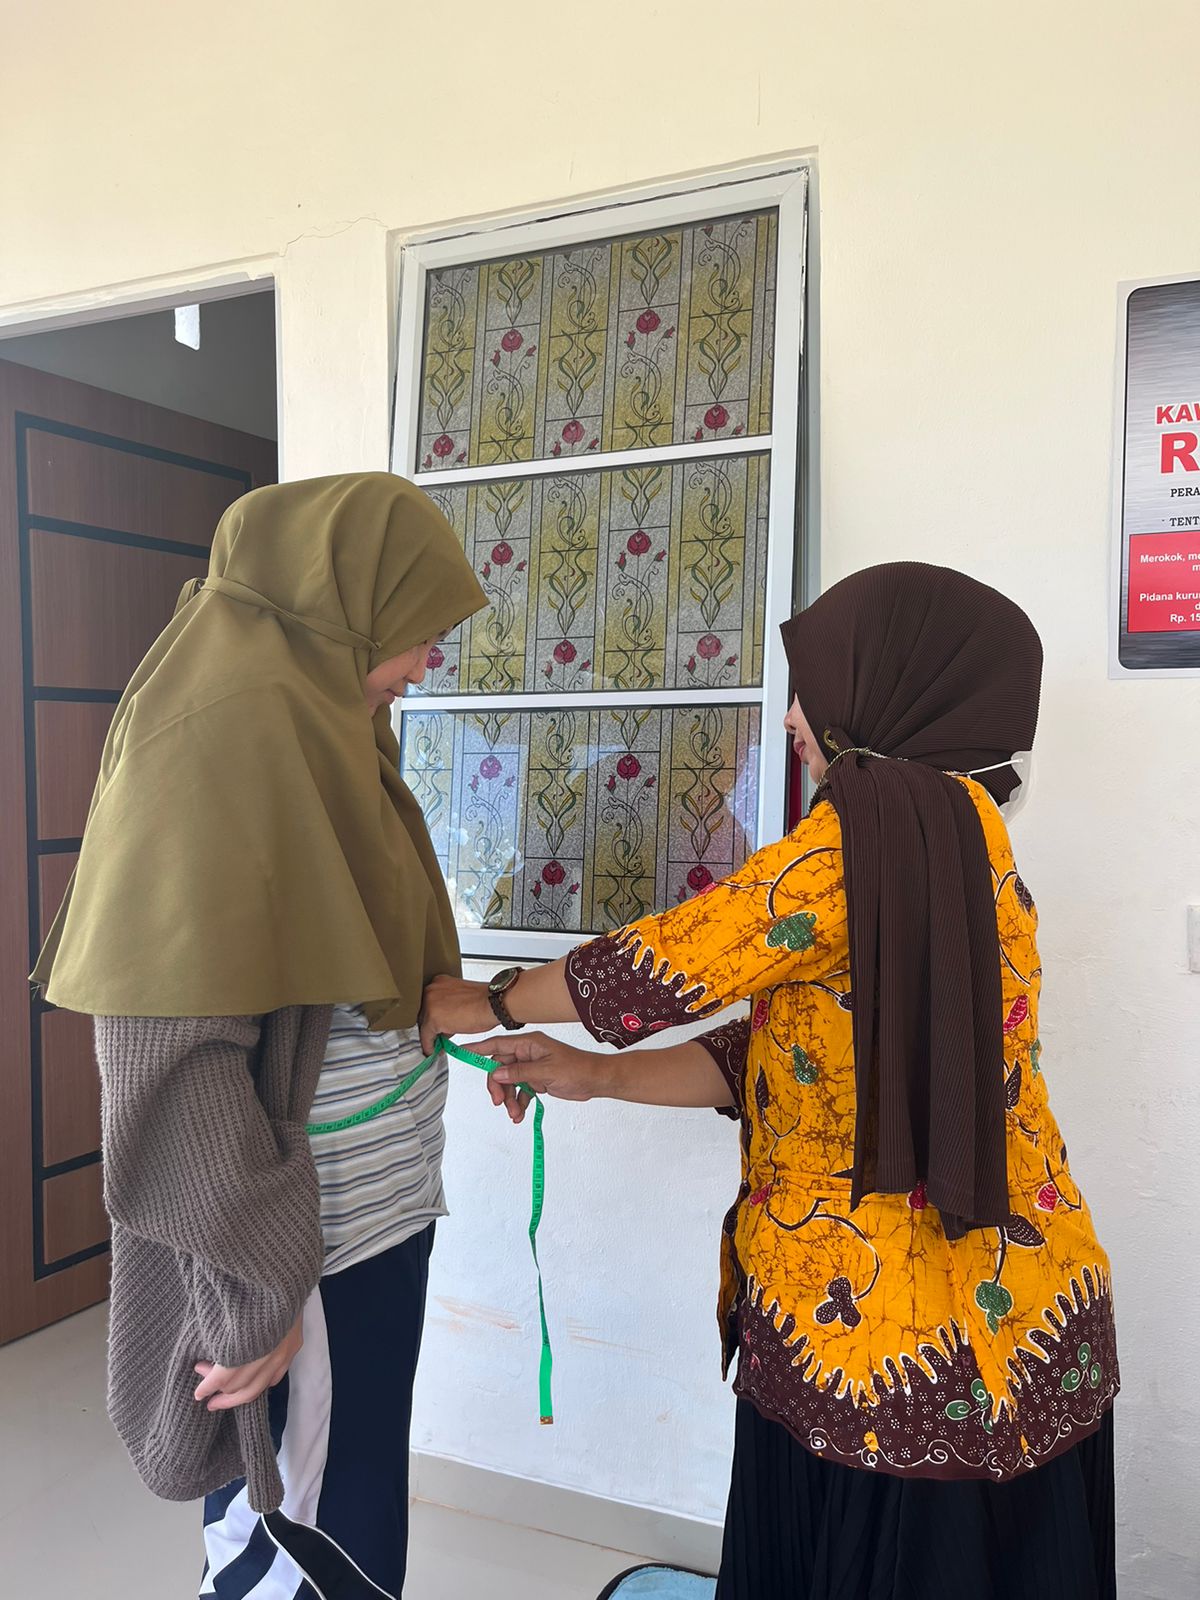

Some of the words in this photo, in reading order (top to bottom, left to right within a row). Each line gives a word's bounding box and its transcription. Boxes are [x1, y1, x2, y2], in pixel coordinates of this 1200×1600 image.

[1140, 553, 1186, 564] Merokok,
[1140, 593, 1173, 602] Pidana
[1176, 591, 1200, 601] kuru
[1170, 613, 1187, 624] Rp.
[474, 1057, 484, 1065] 35
